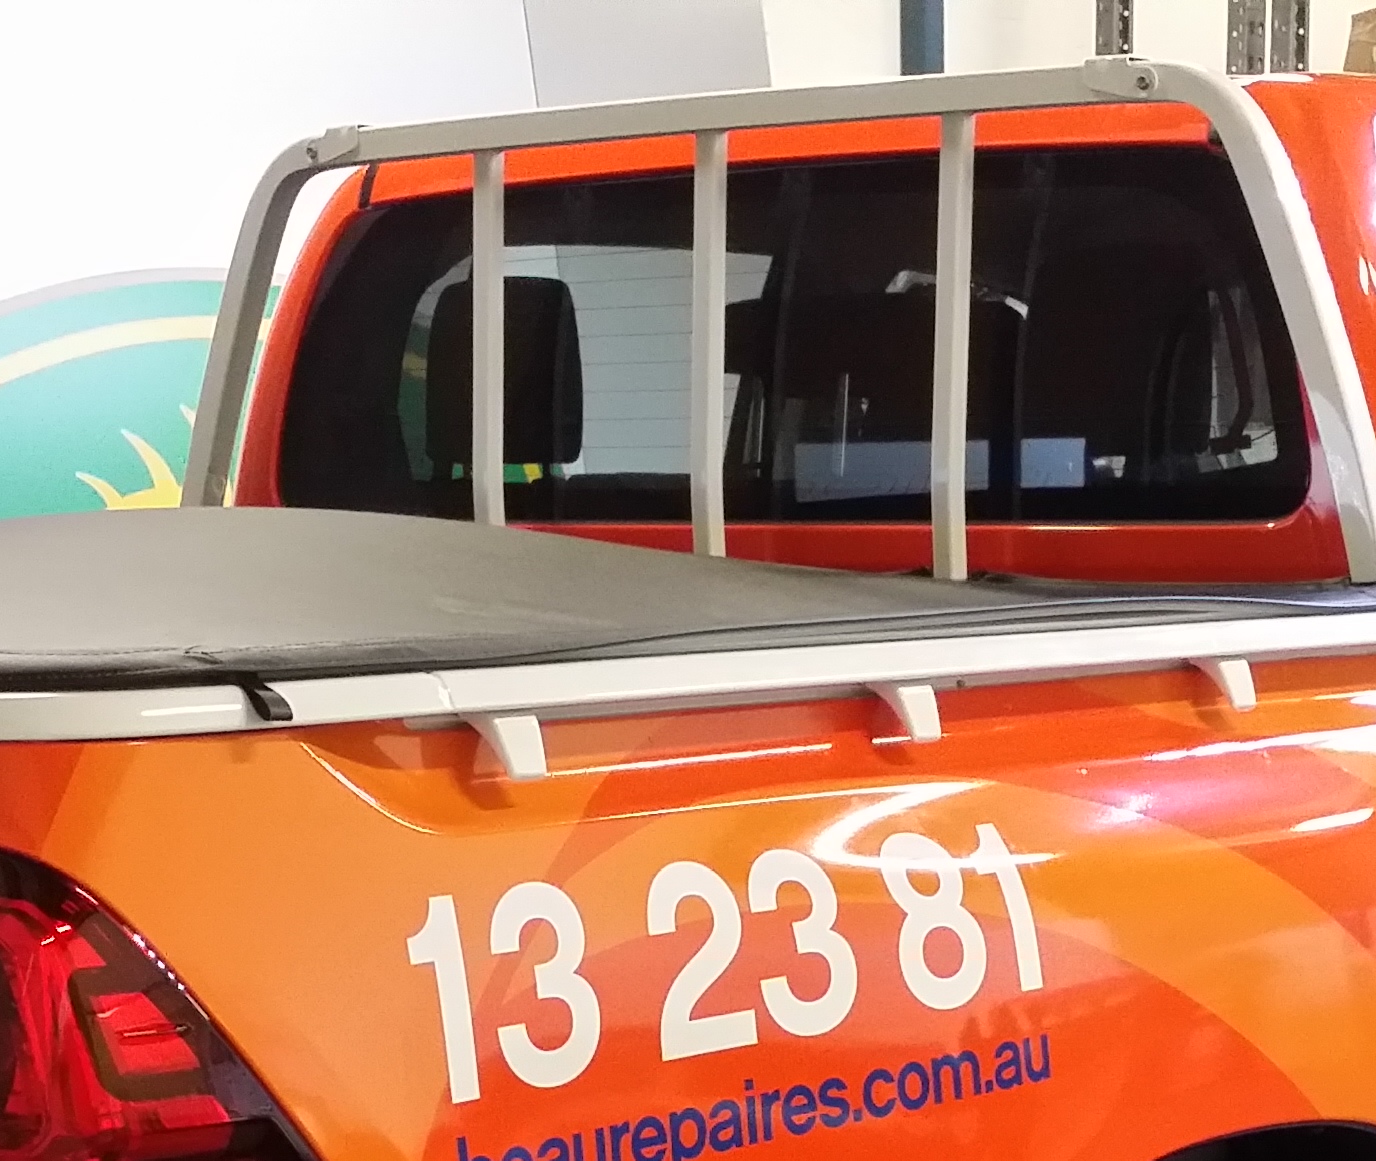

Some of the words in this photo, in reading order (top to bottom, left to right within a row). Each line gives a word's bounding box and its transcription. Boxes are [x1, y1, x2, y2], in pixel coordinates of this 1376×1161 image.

[406, 881, 601, 1104] 13
[646, 848, 858, 1062] 23
[878, 823, 1044, 1010] 81
